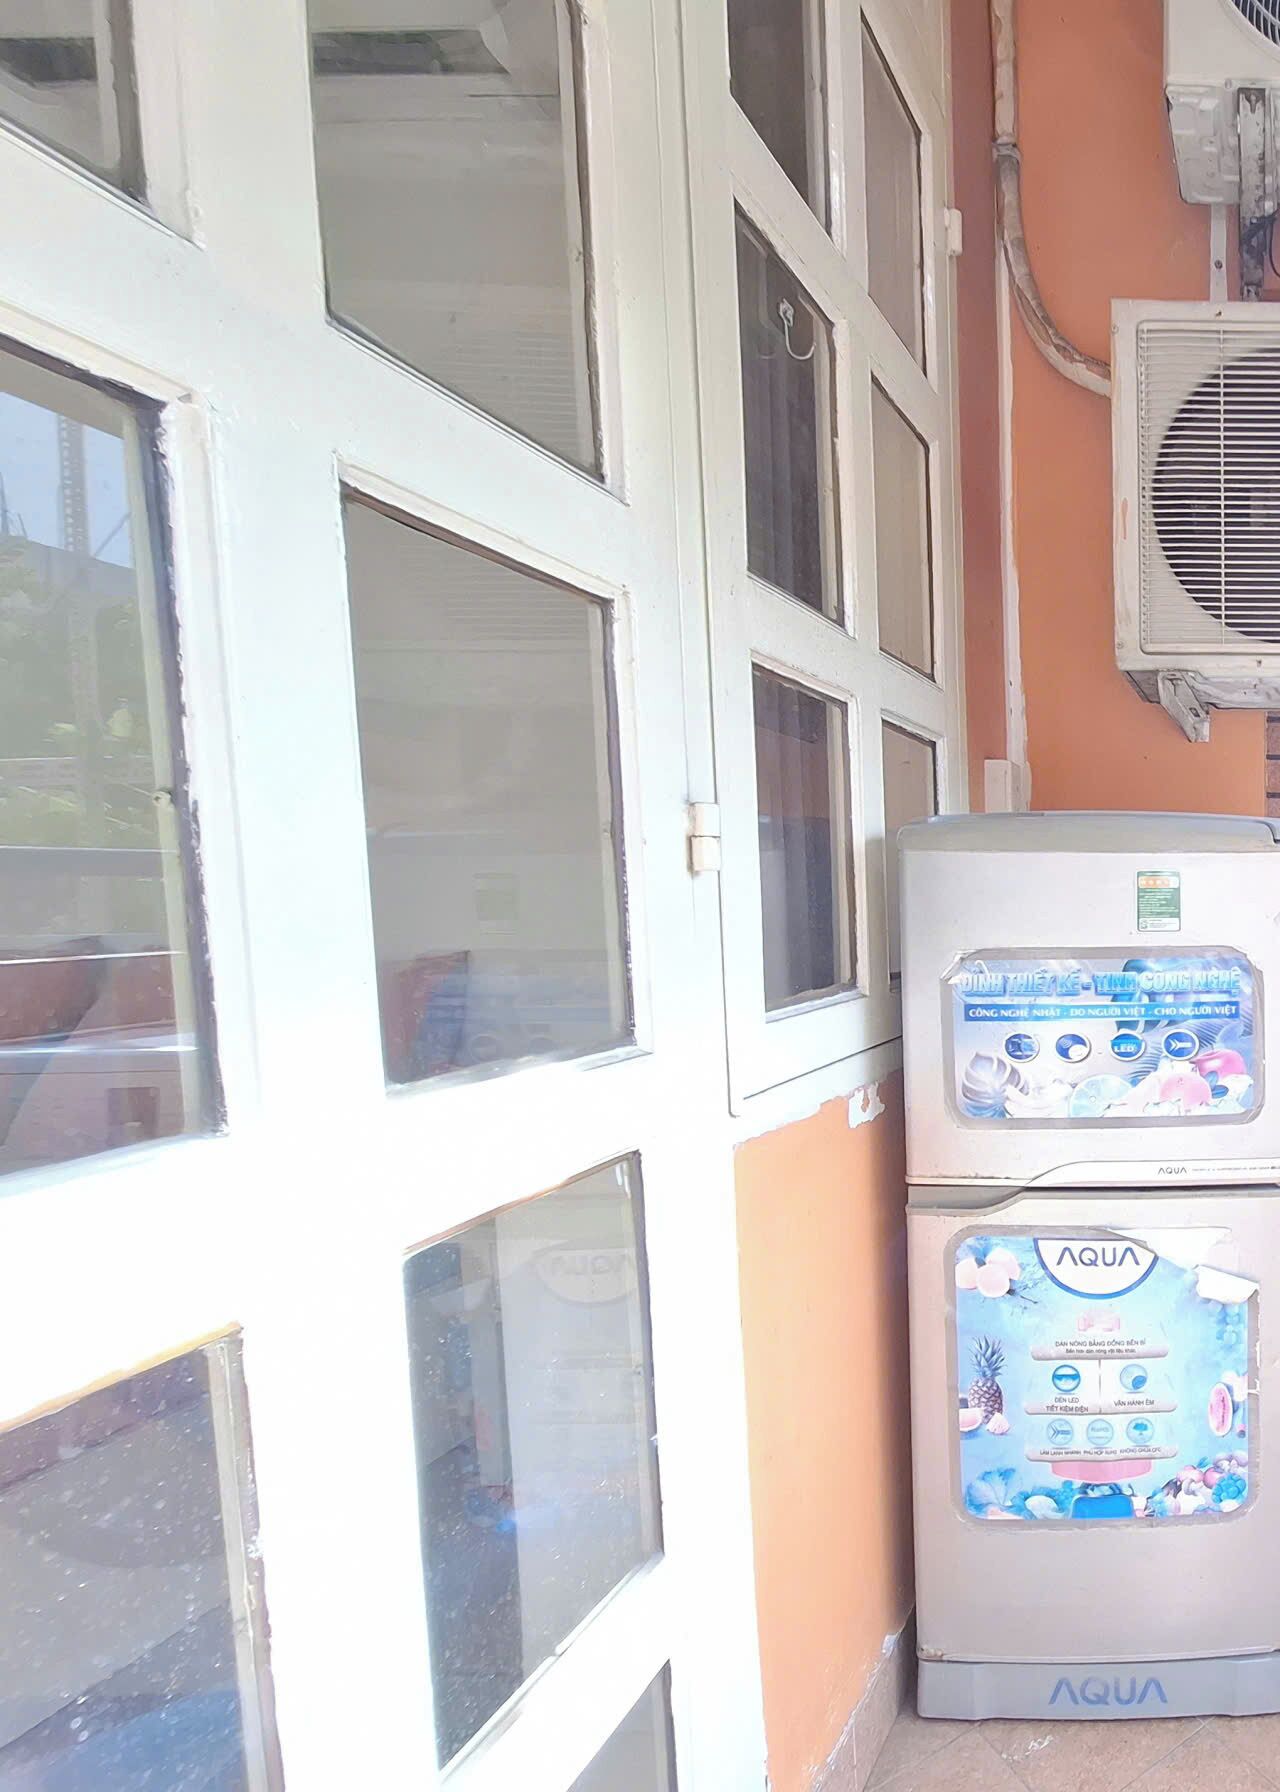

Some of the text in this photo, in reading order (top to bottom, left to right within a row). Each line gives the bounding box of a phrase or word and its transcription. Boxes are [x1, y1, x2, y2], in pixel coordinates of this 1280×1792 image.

[969, 1006, 998, 1018] CÔNG
[1000, 1007, 1029, 1019] NGHỆ
[1154, 1007, 1177, 1016] CHO
[1214, 1004, 1236, 1015] VIỆT
[1056, 1247, 1140, 1267] AQUA
[1048, 1676, 1168, 1705] AQUA
